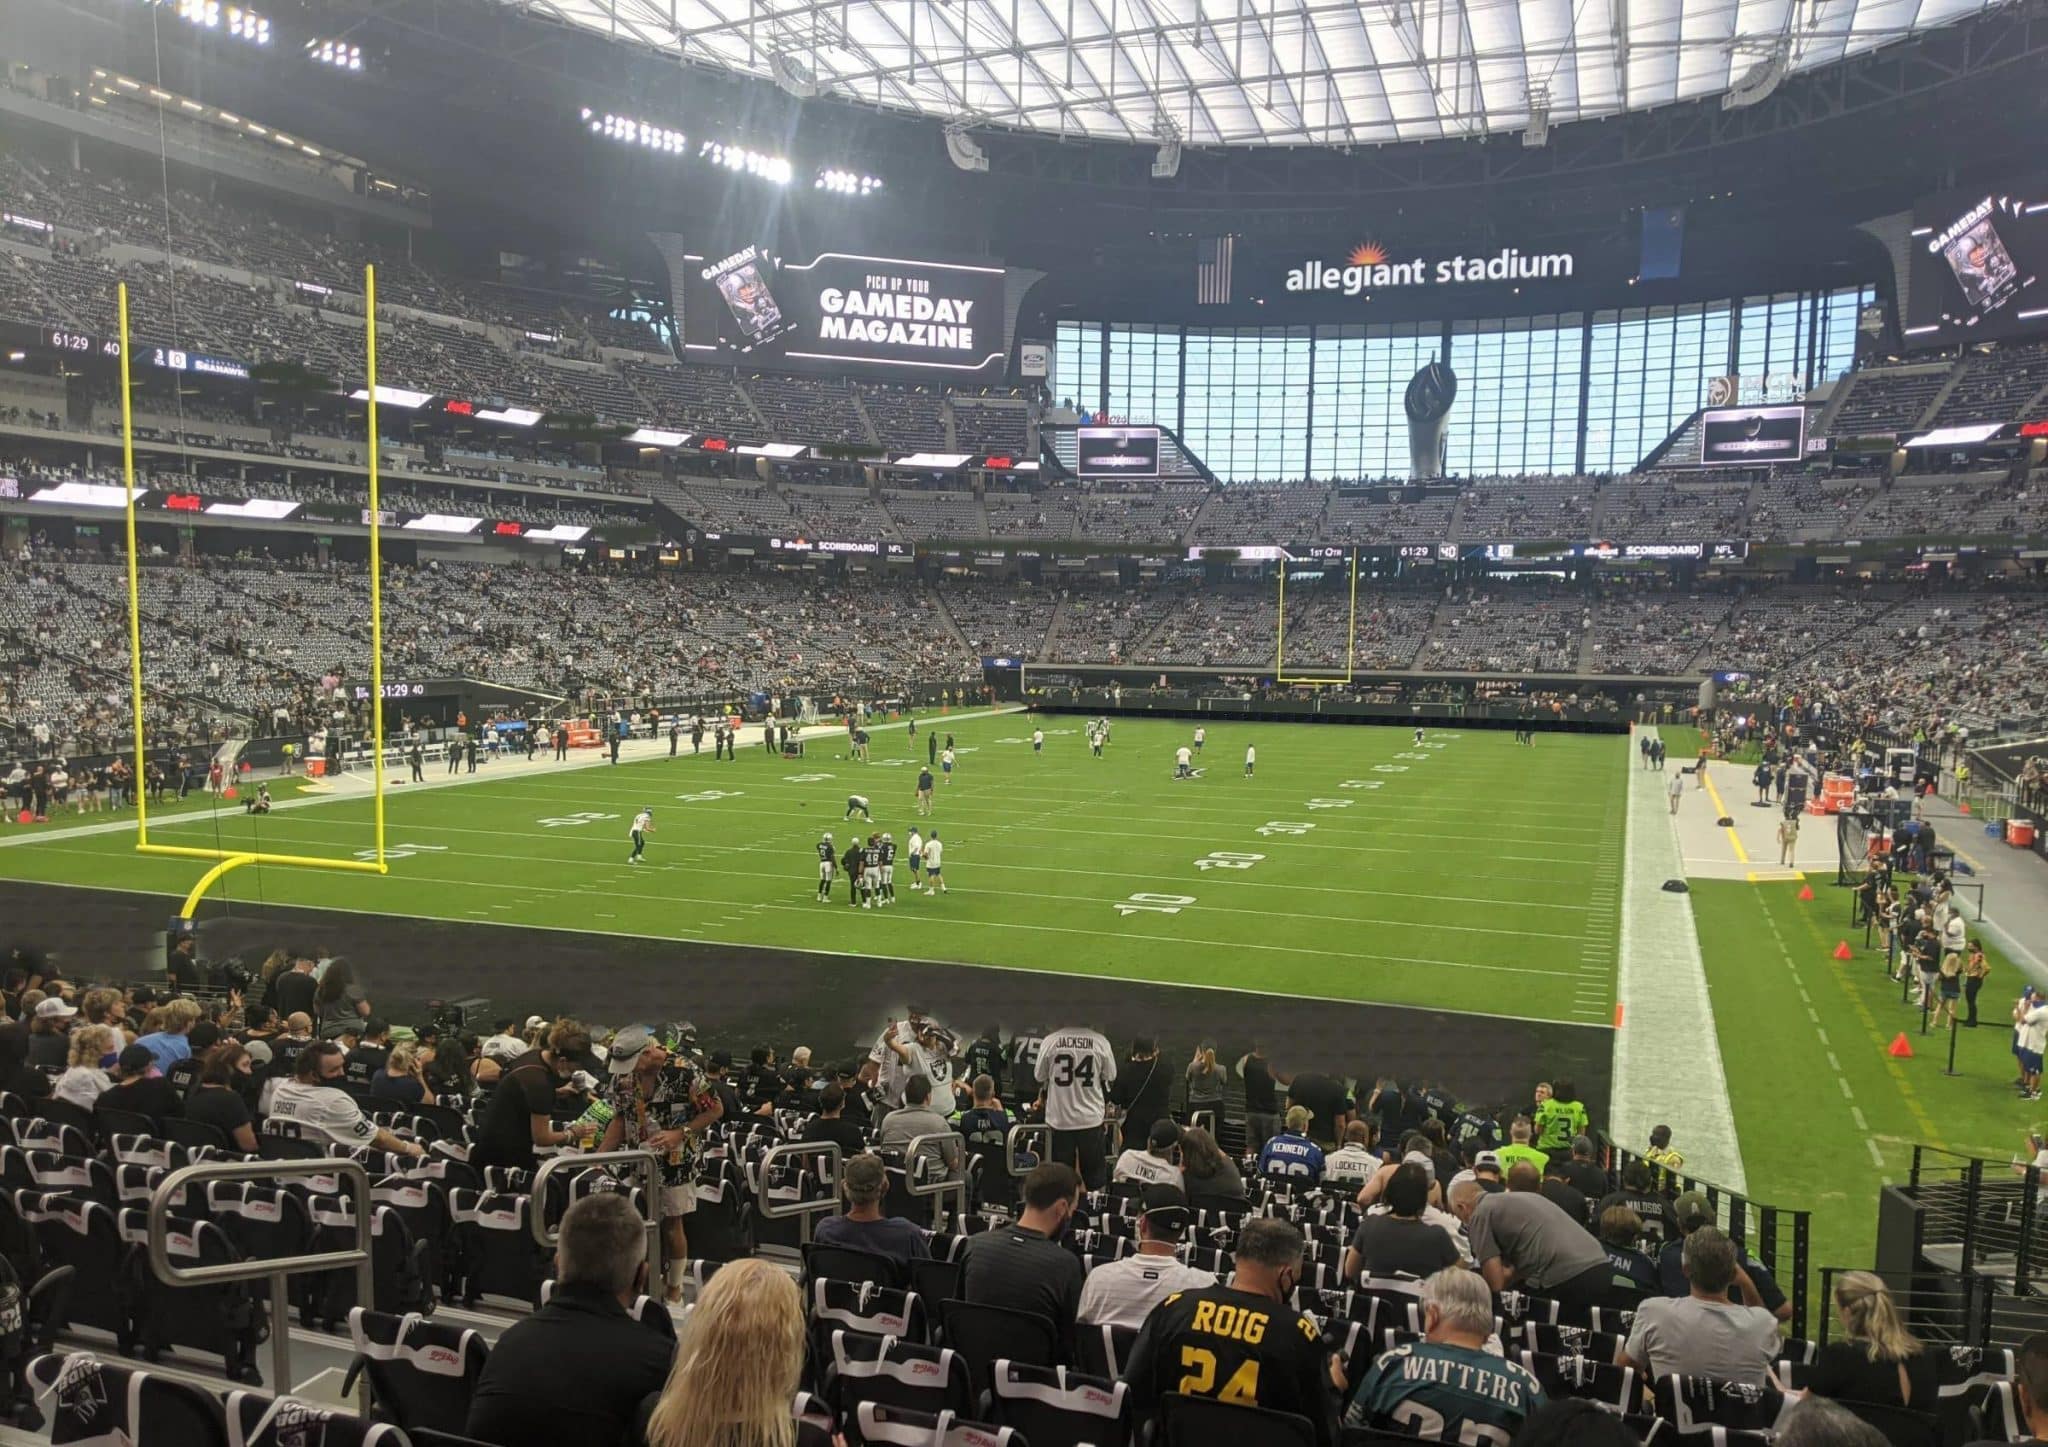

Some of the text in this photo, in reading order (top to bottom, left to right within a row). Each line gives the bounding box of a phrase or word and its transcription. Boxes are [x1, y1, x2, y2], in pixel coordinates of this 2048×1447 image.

[701, 244, 756, 280] GAMEDAY
[1285, 248, 1574, 296] allegiant stadium
[906, 279, 929, 294] YOUR
[820, 288, 974, 324] GAMEDAY
[52, 331, 120, 356] 61:29 40
[820, 316, 973, 350] MAGAZINE
[818, 540, 875, 553] SCOREBOARD
[888, 544, 903, 554] NFL
[1400, 546, 1429, 557] 61:29
[1626, 545, 1699, 556] SCOREBOARD
[1715, 545, 1734, 555] NFL
[412, 684, 424, 696] 40
[1193, 851, 1266, 872] 20
[1113, 892, 1198, 917] 10
[1056, 1036, 1094, 1050] JACKSON
[1054, 1054, 1095, 1088] 34
[273, 1100, 297, 1117] CROSBY
[1557, 1117, 1573, 1142] 3
[1272, 1141, 1310, 1157] KENNEDY
[1135, 1164, 1157, 1179] LYNCH
[1335, 1160, 1369, 1172] LOCKETT
[1608, 1254, 1632, 1272] FAN
[1192, 1301, 1269, 1344] ROIG
[1179, 1345, 1260, 1407] 24
[1403, 1356, 1521, 1407] WATTERS
